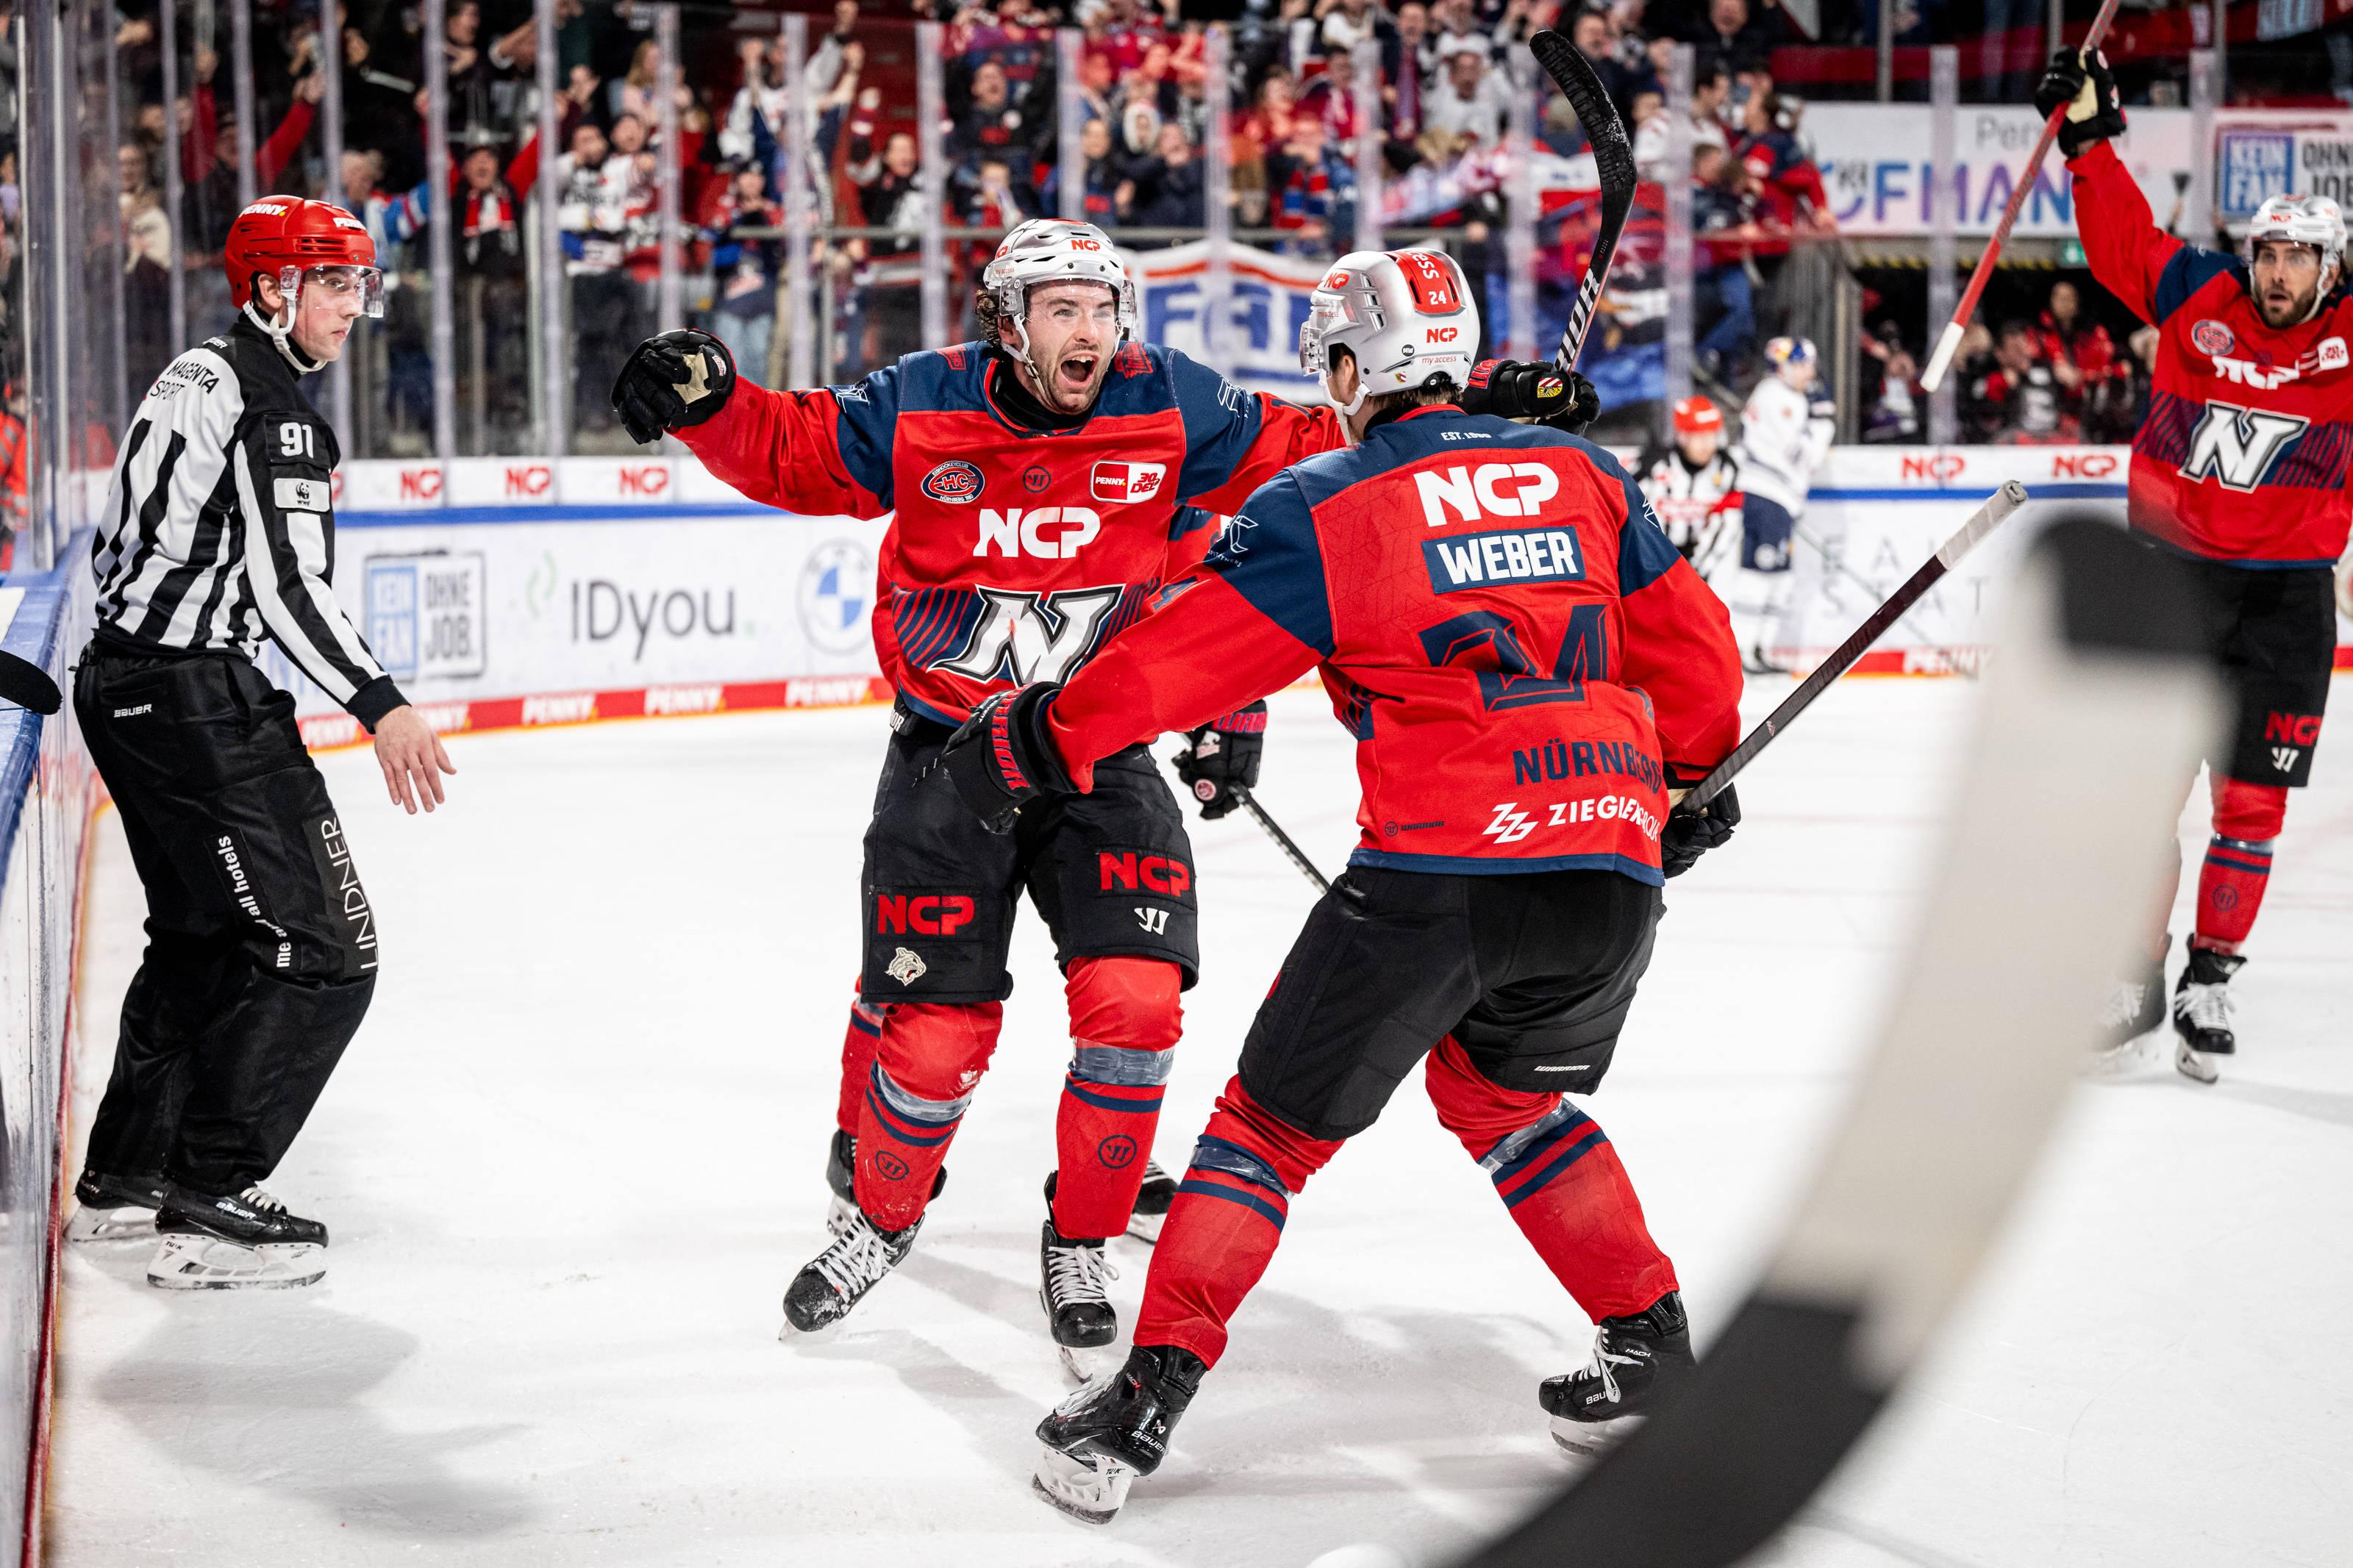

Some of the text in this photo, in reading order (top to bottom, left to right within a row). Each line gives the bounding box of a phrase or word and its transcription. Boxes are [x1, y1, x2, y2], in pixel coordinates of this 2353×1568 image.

[1071, 239, 1101, 251] NCP
[1324, 273, 1350, 290] NCP
[1428, 290, 1447, 305] 24
[1427, 327, 1458, 343] NCP
[1421, 355, 1457, 365] my access
[167, 360, 220, 395] MAGENTA
[149, 381, 185, 401] SPORT
[279, 422, 314, 459] 91
[1137, 472, 1158, 483] 30
[1901, 454, 1965, 480] NCP
[2052, 454, 2118, 479] NCP
[401, 469, 441, 501] NCP
[505, 465, 551, 496] NCP
[618, 465, 668, 495] NCP
[1413, 462, 1560, 528] NCP
[972, 506, 1101, 559] NCP
[1436, 531, 1579, 585] WEBER
[1418, 604, 1610, 712] 24
[113, 704, 152, 718] BAUER
[1513, 737, 1663, 795] NÜRNBERG
[1401, 820, 1445, 832] WARRIOR
[217, 835, 250, 894] hotels
[1099, 851, 1193, 898] NCP
[238, 895, 261, 917] all
[321, 817, 378, 970] LINDNER
[876, 894, 976, 936] NCP
[276, 942, 292, 968] me
[1534, 1064, 1591, 1073] WARRIOR
[215, 1200, 257, 1220] BAUER
[1625, 1348, 1652, 1358] MACH
[1125, 1372, 1141, 1389] MACH
[1585, 1391, 1606, 1406] BAU
[1130, 1430, 1166, 1454] BAUER
